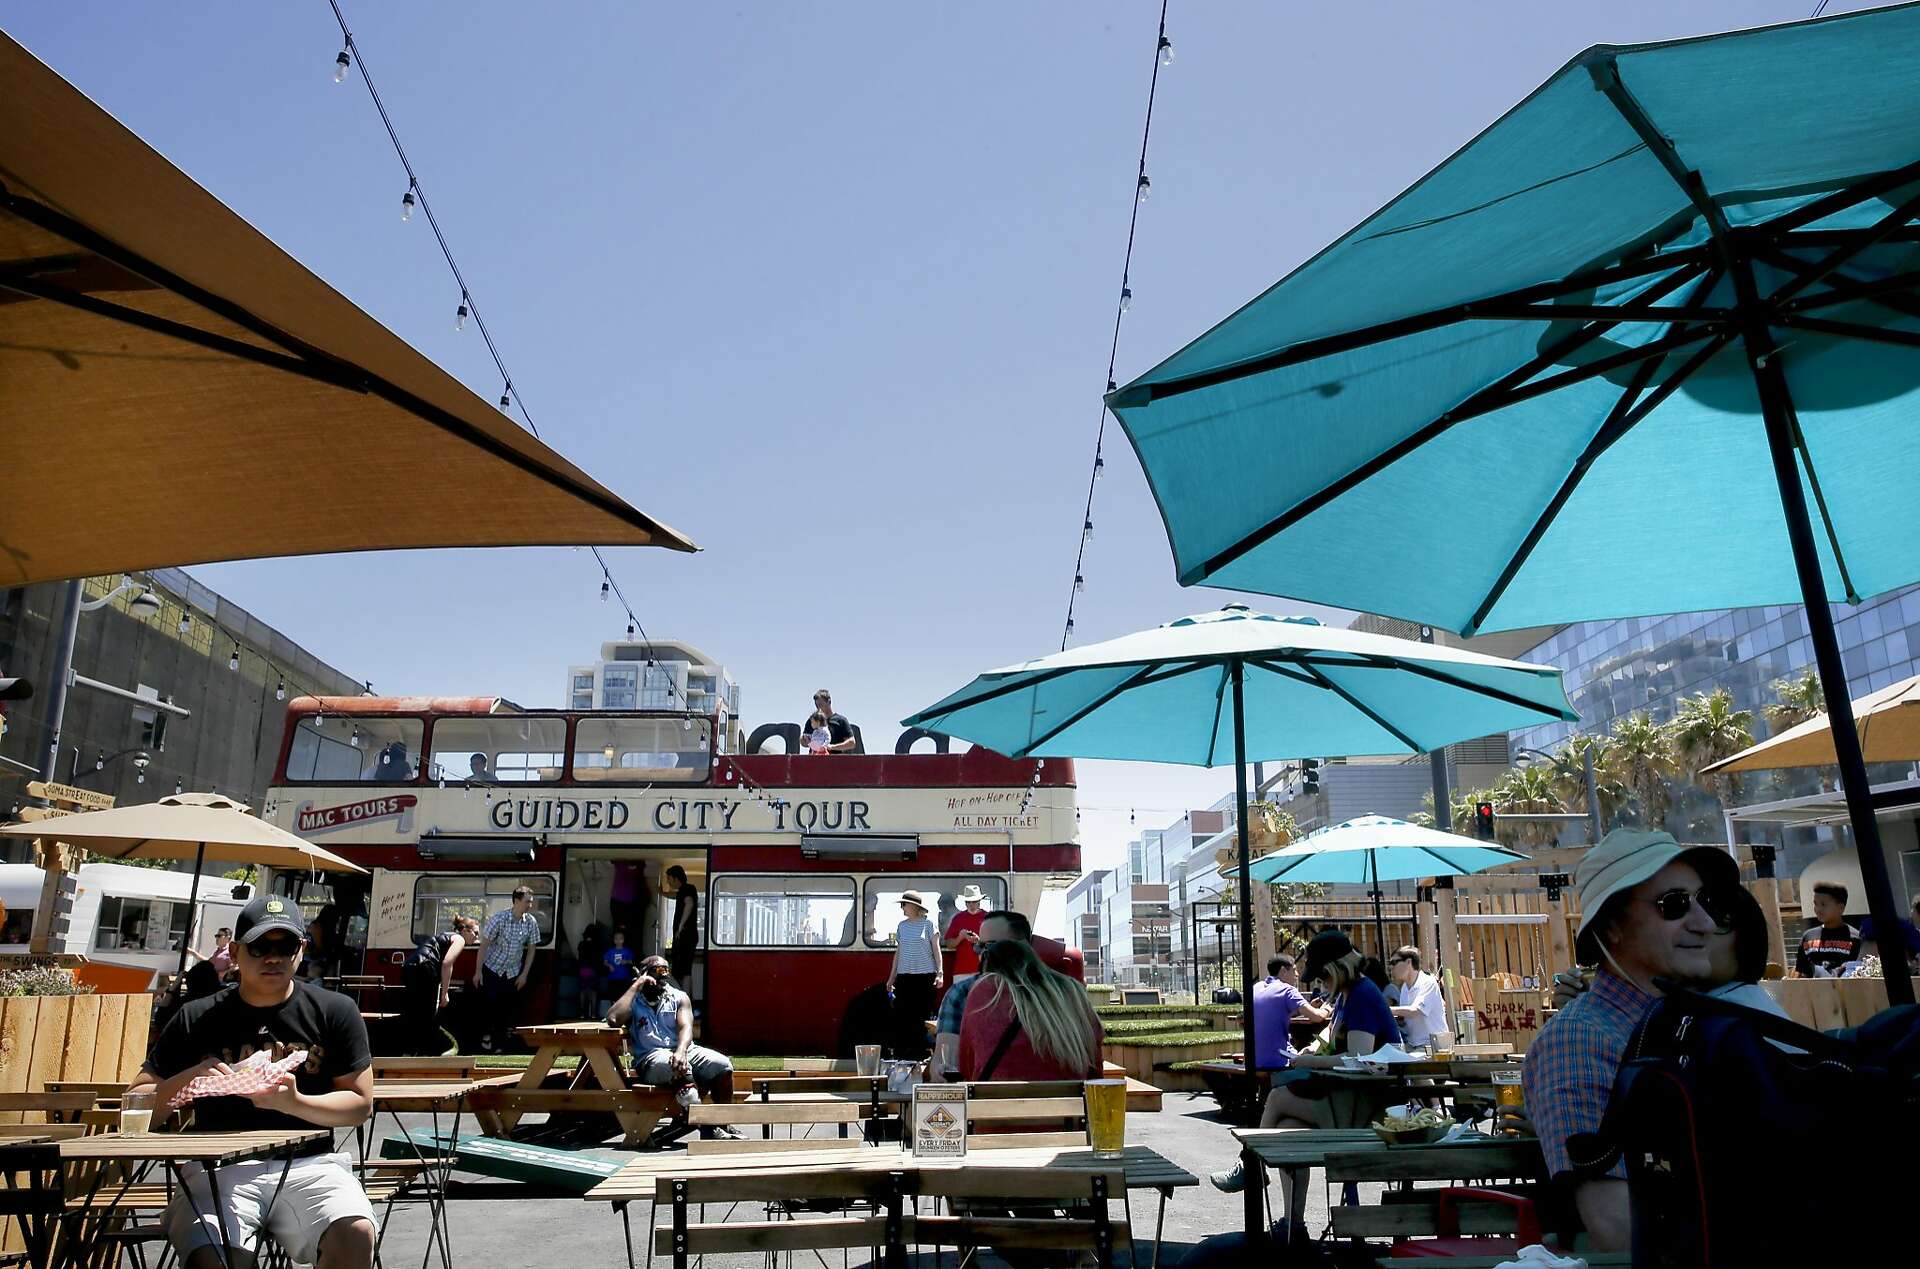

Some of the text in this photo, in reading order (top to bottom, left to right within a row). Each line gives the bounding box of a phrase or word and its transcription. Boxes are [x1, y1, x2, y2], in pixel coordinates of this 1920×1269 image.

[47, 784, 64, 795] SOMA
[65, 788, 86, 800] STREAT
[86, 793, 101, 804] FOOD
[303, 798, 398, 829] MAC TOURS
[491, 800, 871, 829] GUIDED CITY TOUR
[954, 816, 1039, 827] ALL DAY TICKET
[14, 956, 58, 967] SWINGS
[1486, 1003, 1524, 1014] SPARK
[918, 1092, 963, 1100] HAPPY HOUR
